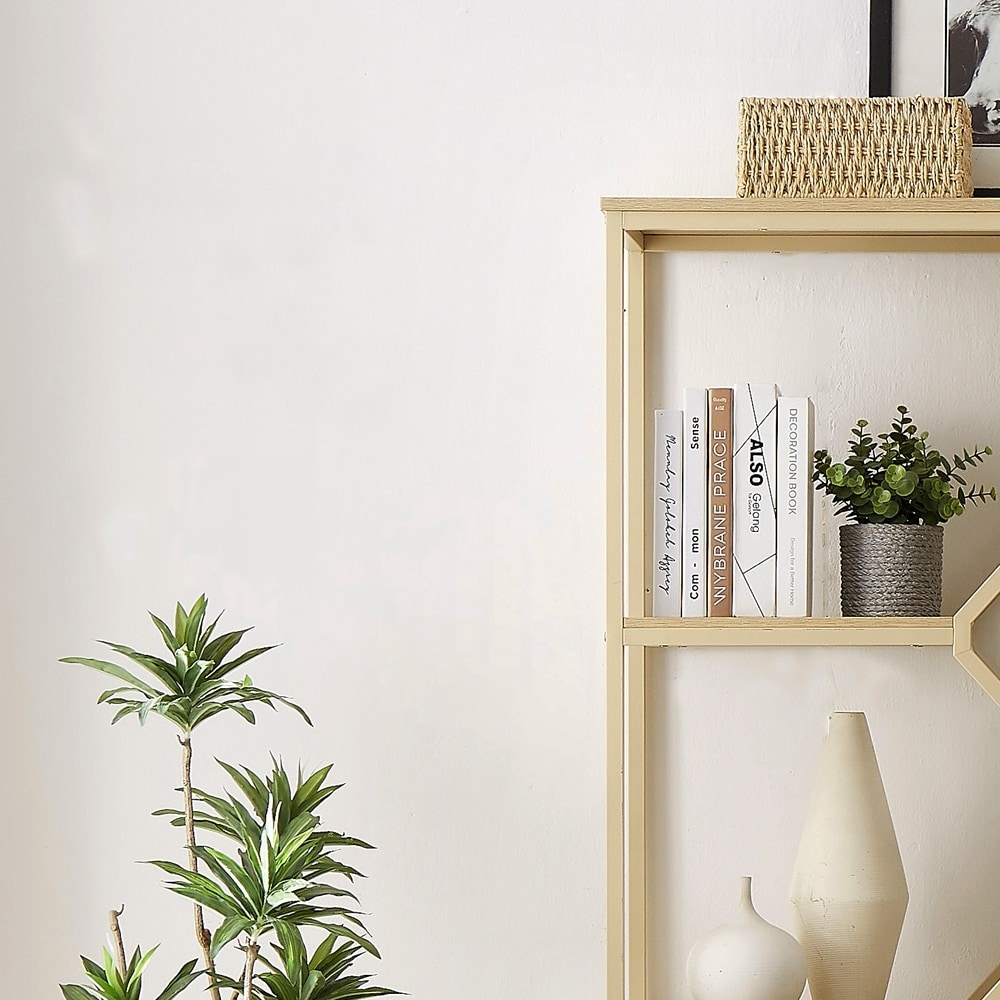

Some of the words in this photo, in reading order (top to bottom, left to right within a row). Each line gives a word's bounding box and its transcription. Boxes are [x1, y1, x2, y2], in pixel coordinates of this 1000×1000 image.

[690, 416, 700, 450] Sense
[789, 408, 798, 480] DECORATION
[713, 430, 727, 496] PRACE
[750, 438, 764, 486] ALSO
[750, 492, 762, 534] Gelang
[788, 482, 797, 515] BOOK
[713, 504, 727, 606] WYBRANE
[690, 574, 699, 600] Com
